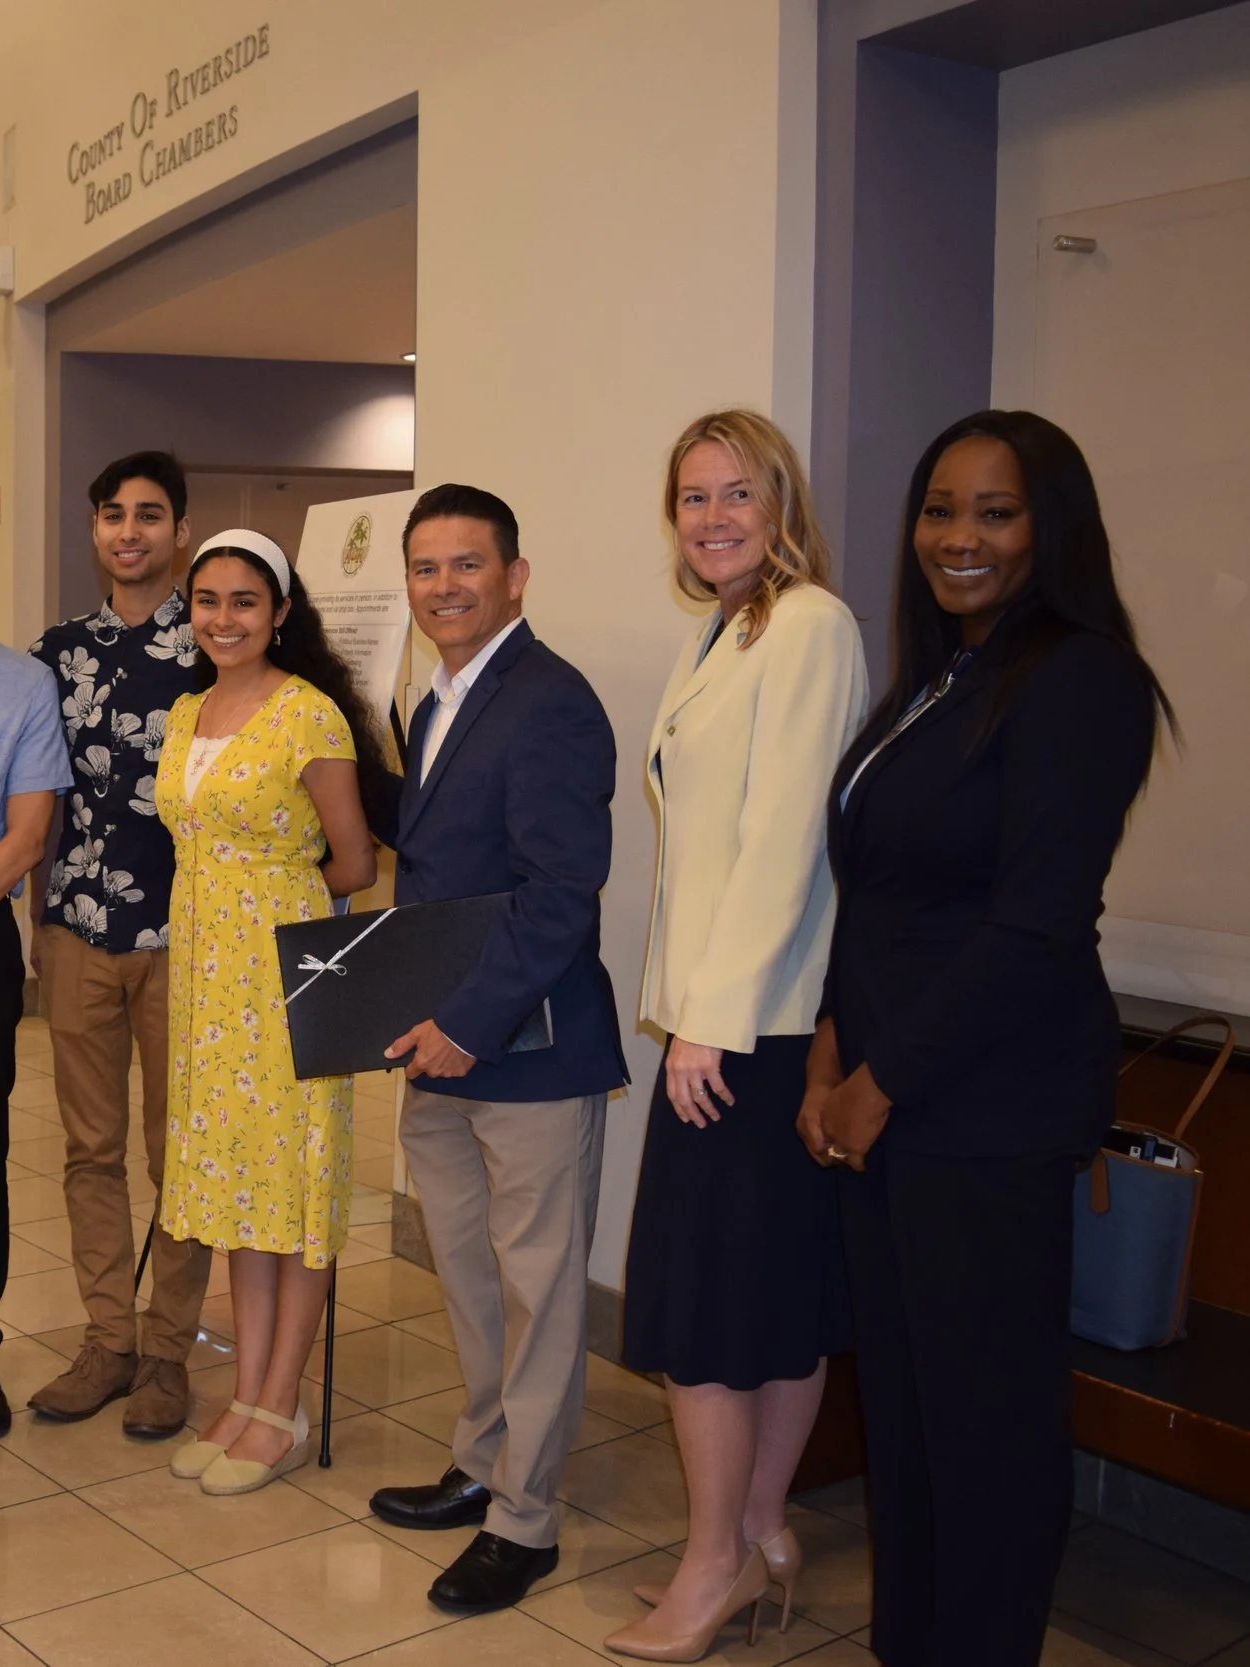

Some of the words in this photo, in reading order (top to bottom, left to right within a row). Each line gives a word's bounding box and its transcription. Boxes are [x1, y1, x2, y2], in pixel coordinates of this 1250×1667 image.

[67, 121, 125, 186] COUNTY
[130, 91, 158, 139] OF
[165, 22, 270, 118] RIVERSIDE
[84, 171, 132, 225] BOARD
[139, 103, 238, 188] CHAMBERS
